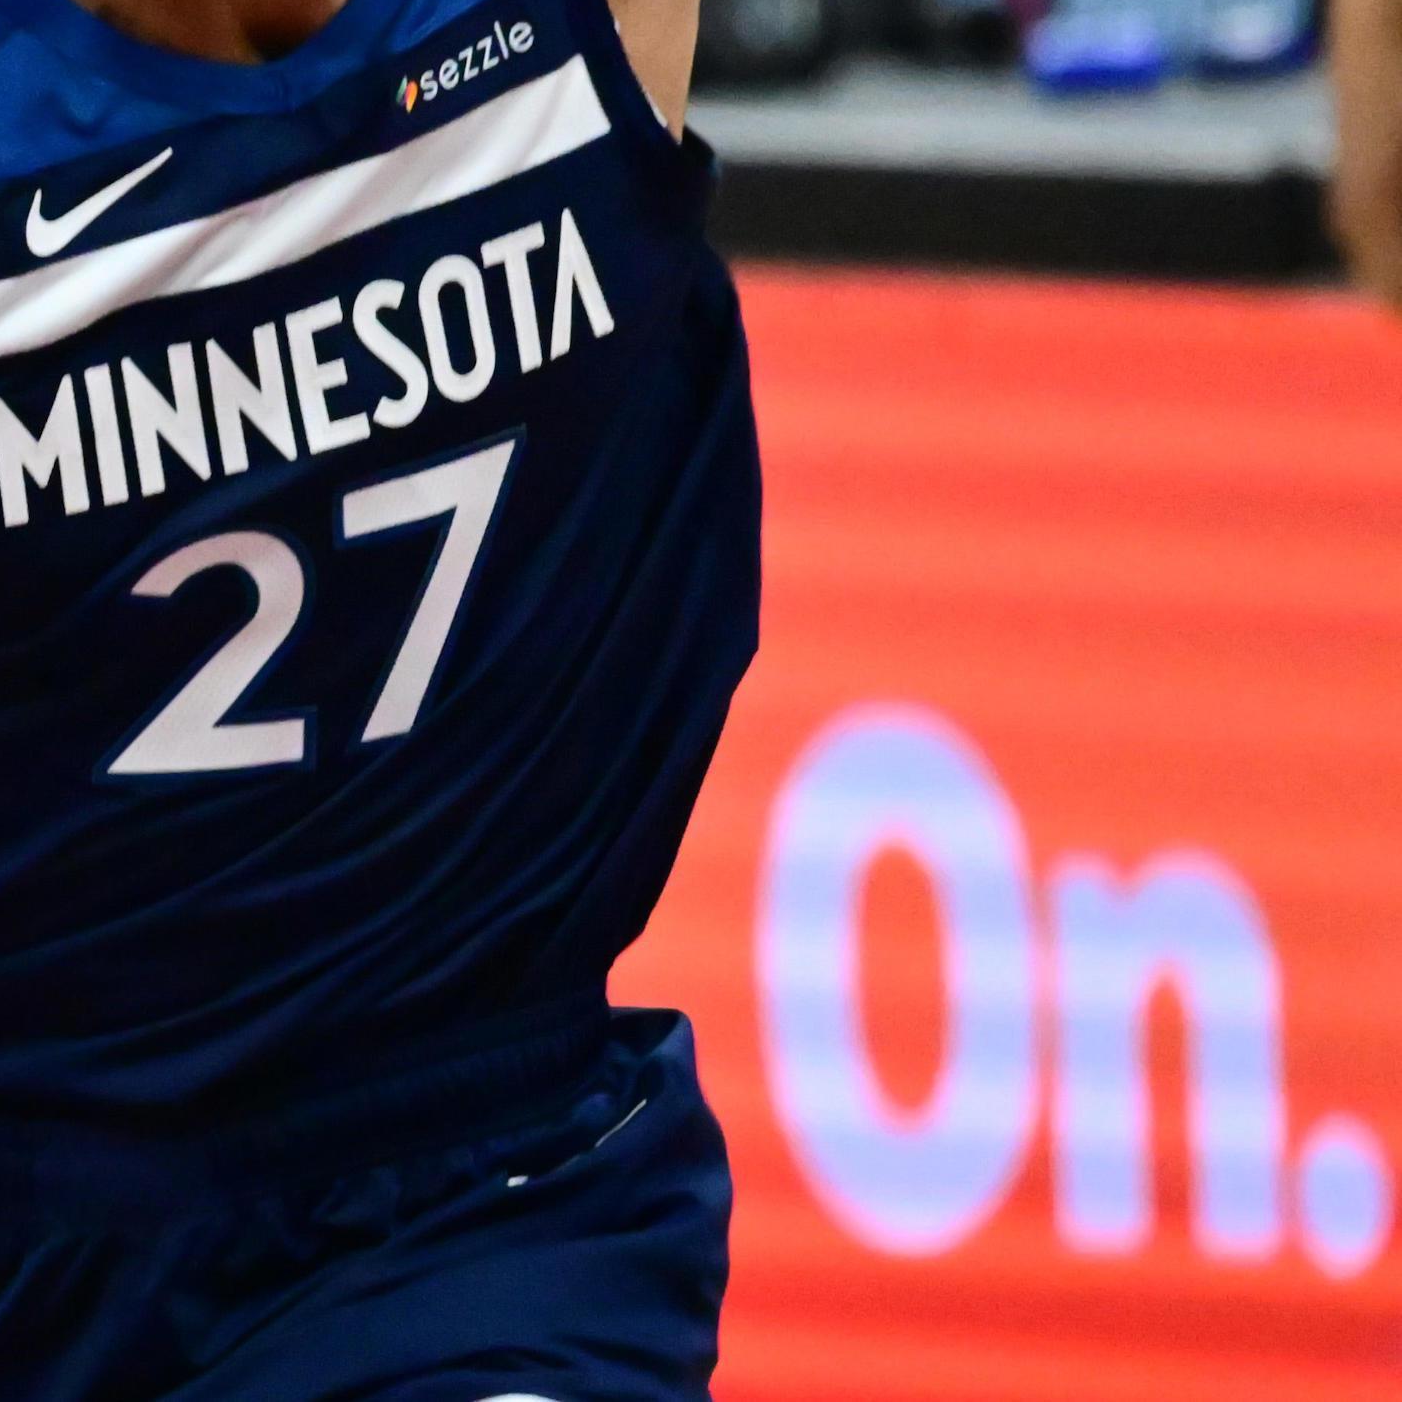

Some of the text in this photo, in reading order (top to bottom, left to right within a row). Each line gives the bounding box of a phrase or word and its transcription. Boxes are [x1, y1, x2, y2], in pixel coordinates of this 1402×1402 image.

[419, 18, 535, 102] sezzle
[102, 434, 521, 778] 27
[754, 702, 1390, 1280] On.
